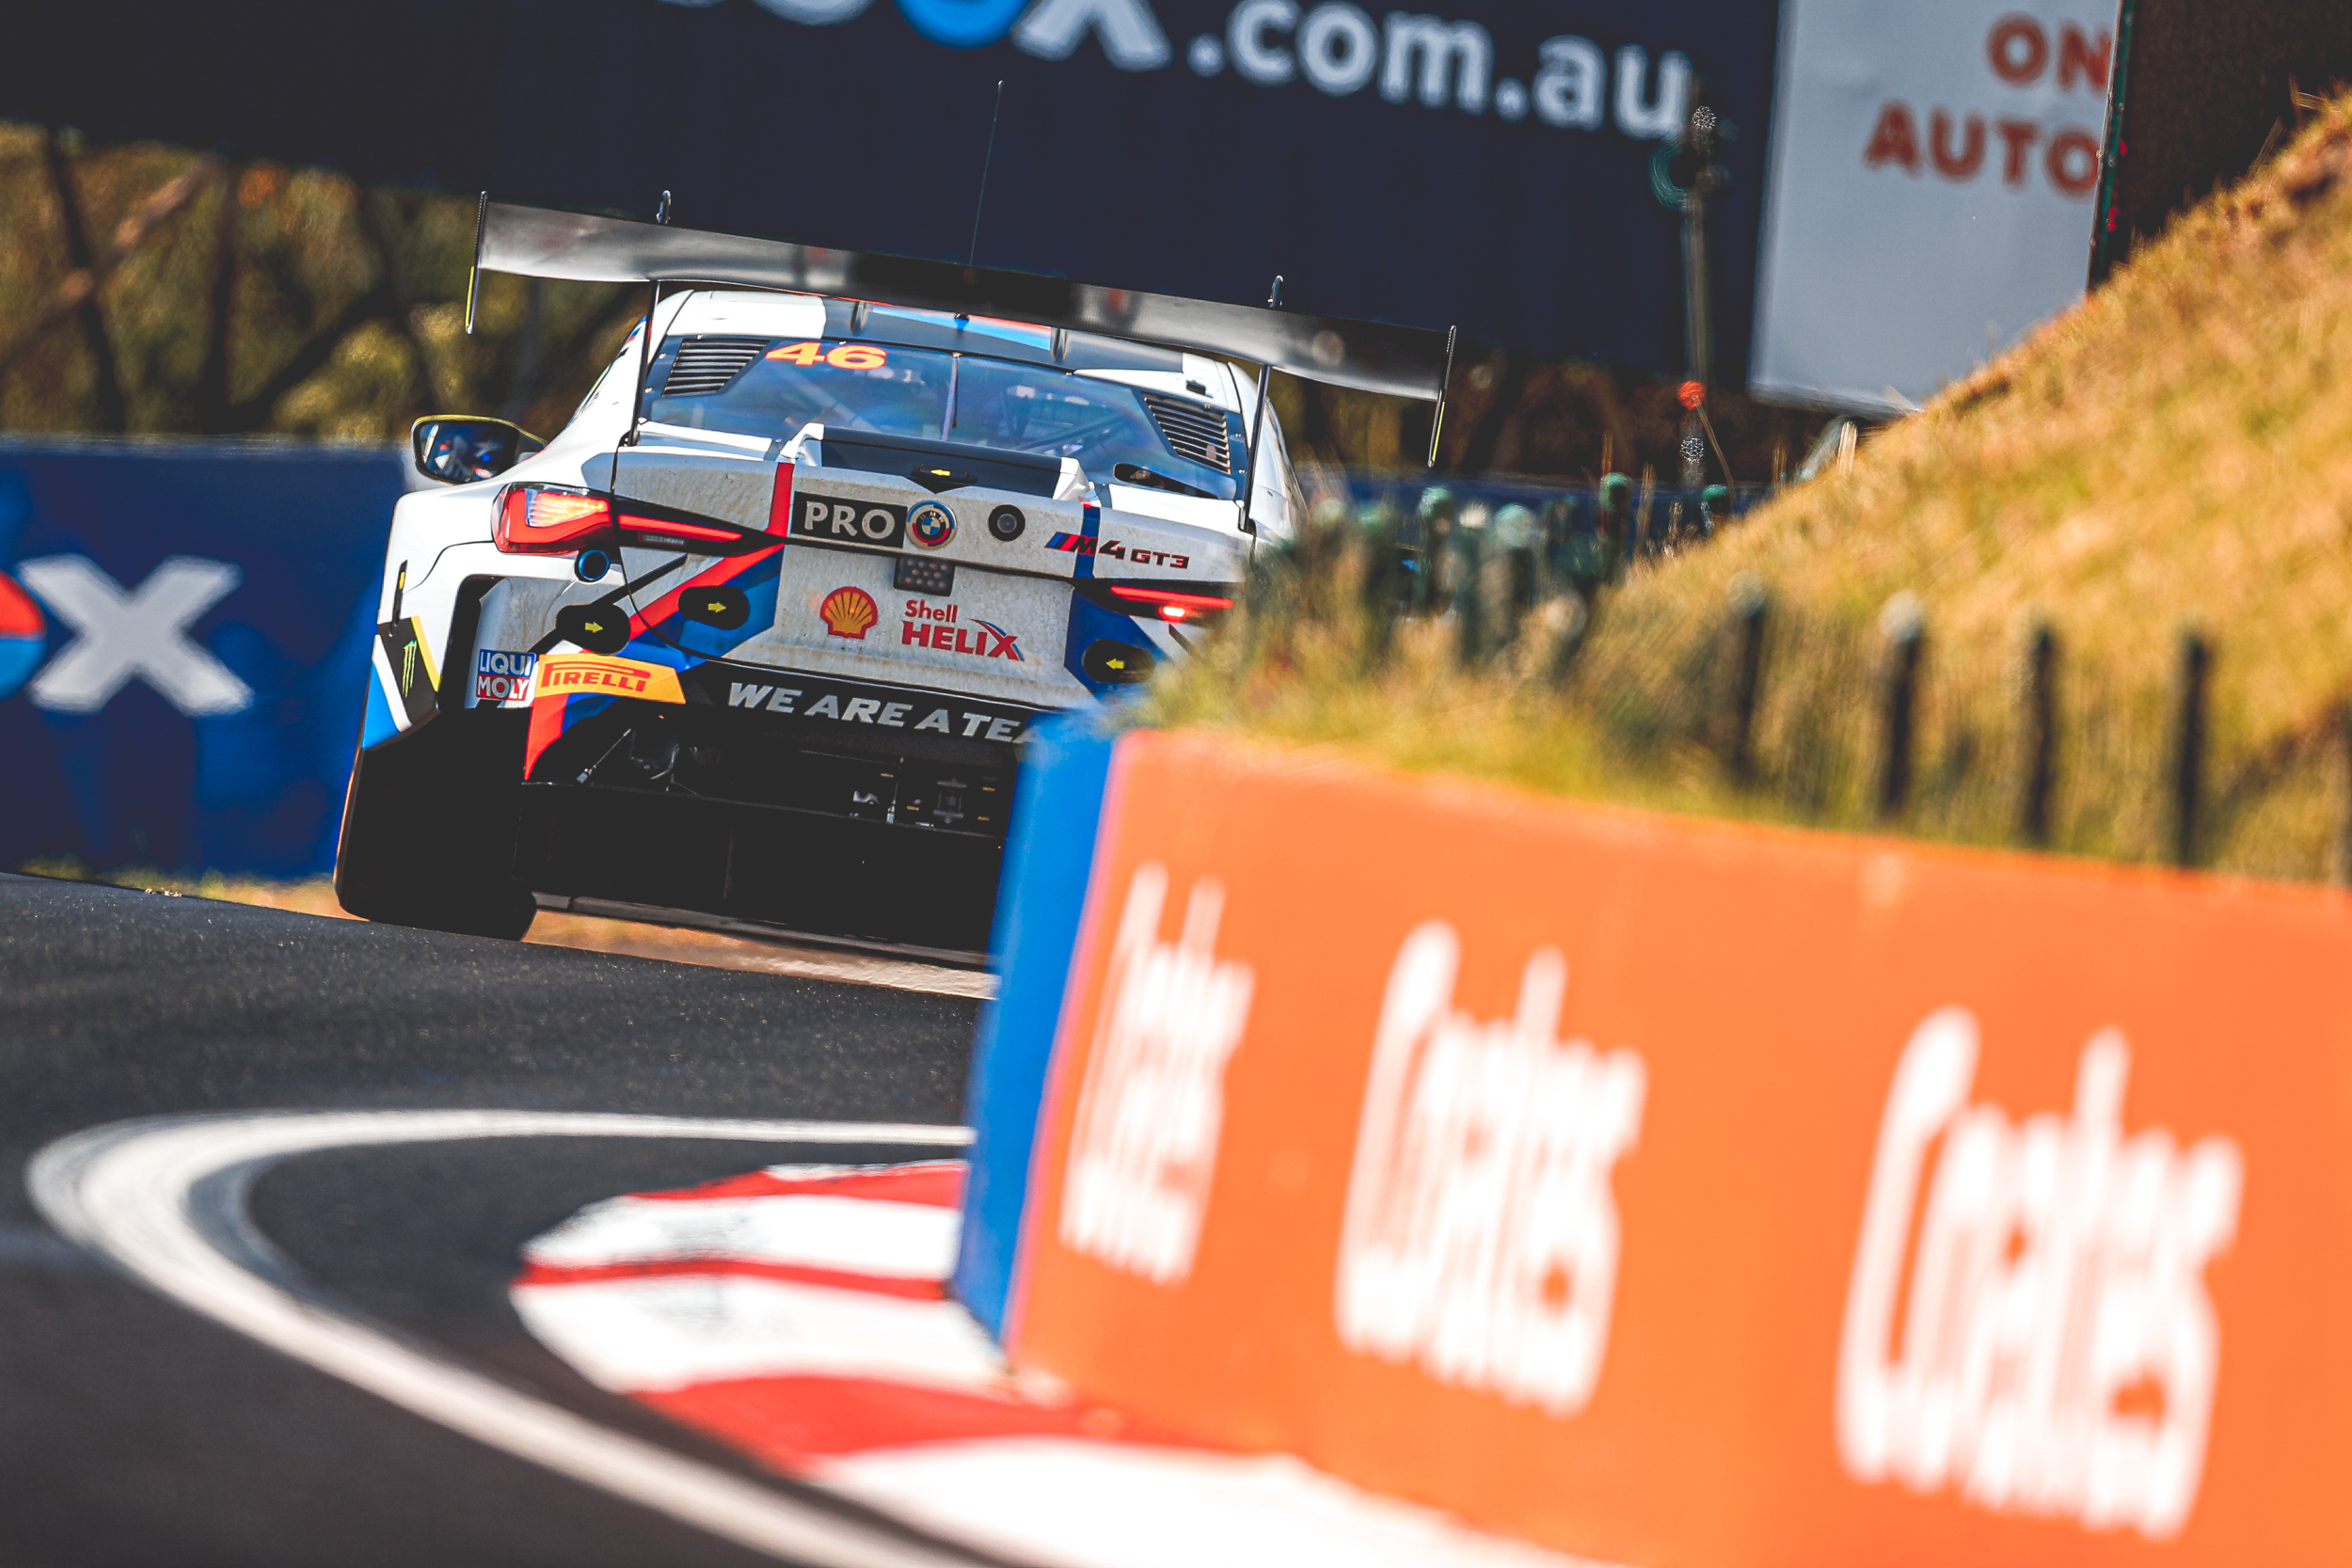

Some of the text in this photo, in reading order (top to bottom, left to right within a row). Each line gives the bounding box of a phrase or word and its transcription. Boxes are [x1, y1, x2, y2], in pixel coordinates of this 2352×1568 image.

[1862, 100, 2101, 202] AUTO
[765, 341, 887, 371] 46
[804, 500, 895, 540] PRO
[1130, 548, 1190, 569] GT3
[904, 599, 959, 623] Shell
[900, 618, 1024, 661] HELIX
[480, 651, 533, 675] LIQUI
[540, 661, 651, 691] PIRELLI
[477, 675, 530, 700] MOLY
[728, 682, 803, 713] WE
[804, 694, 914, 727] ARE
[914, 709, 950, 734] A
